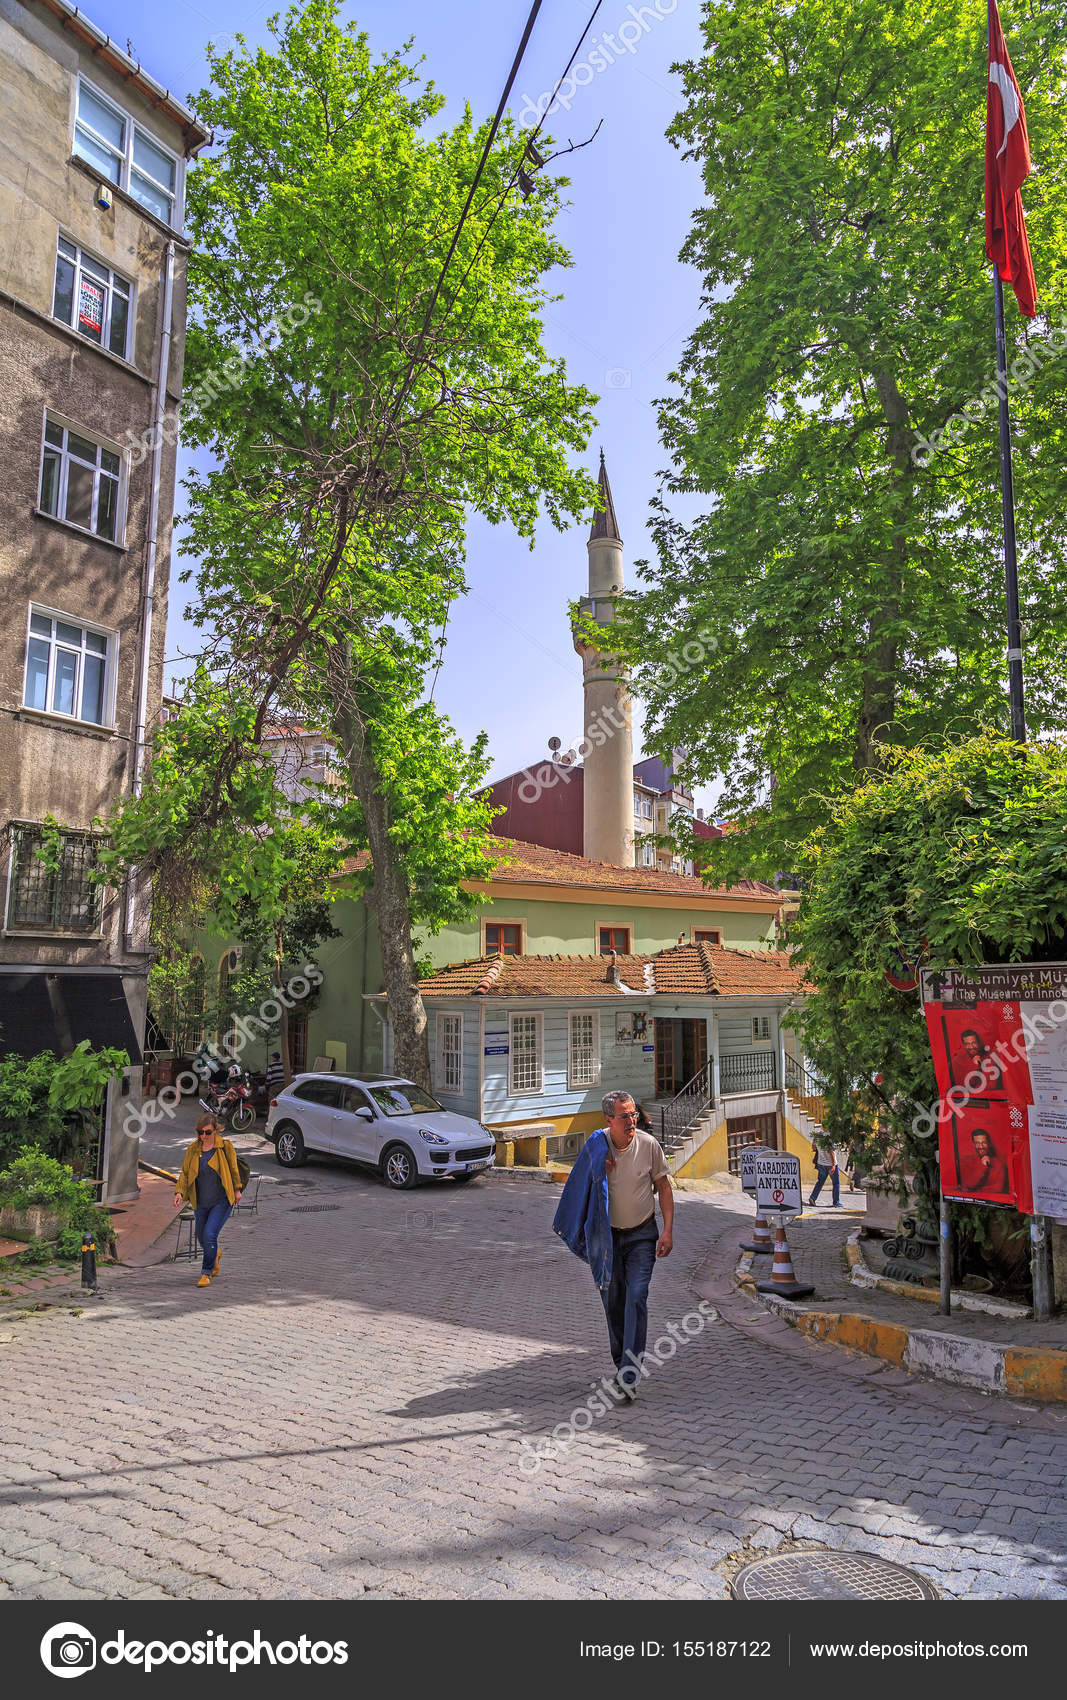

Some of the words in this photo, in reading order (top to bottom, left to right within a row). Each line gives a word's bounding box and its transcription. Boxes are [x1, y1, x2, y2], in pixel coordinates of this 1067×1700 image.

[979, 987, 1021, 1000] Museum
[1024, 987, 1035, 1000] of
[757, 1160, 797, 1175] KARADENİZ
[758, 1175, 798, 1190] ANTİKA
